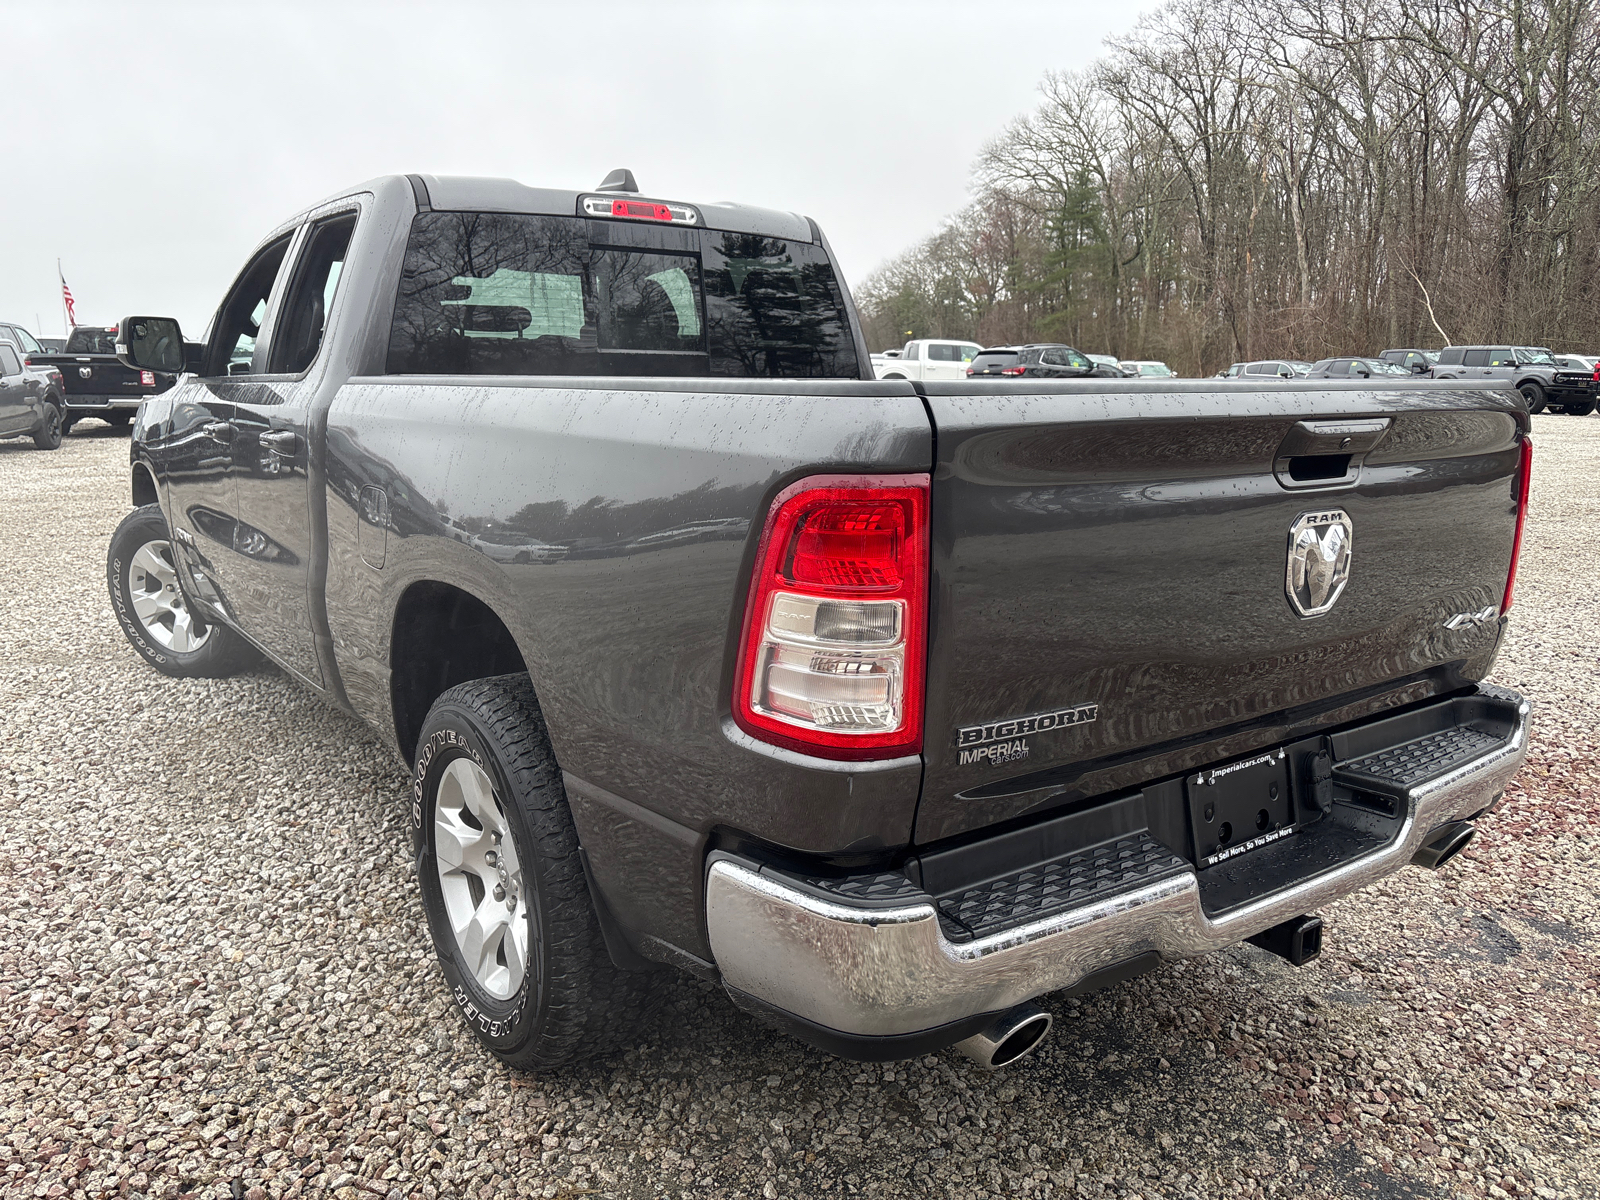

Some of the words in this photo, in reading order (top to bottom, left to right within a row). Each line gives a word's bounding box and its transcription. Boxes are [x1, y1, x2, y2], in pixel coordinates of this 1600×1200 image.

[1306, 512, 1343, 524] RAM
[113, 558, 167, 664] GOODYEAR
[959, 738, 1030, 765] IMPERIAL
[991, 750, 1029, 765] cars.com
[412, 729, 484, 829] GOODYEAR
[1211, 754, 1271, 778] Imperialcars.com
[1208, 855, 1218, 865] We
[1218, 851, 1230, 860] Sell
[1230, 846, 1246, 856] More,
[1254, 837, 1265, 846] You
[1265, 832, 1279, 842] Save
[1279, 827, 1293, 837] More
